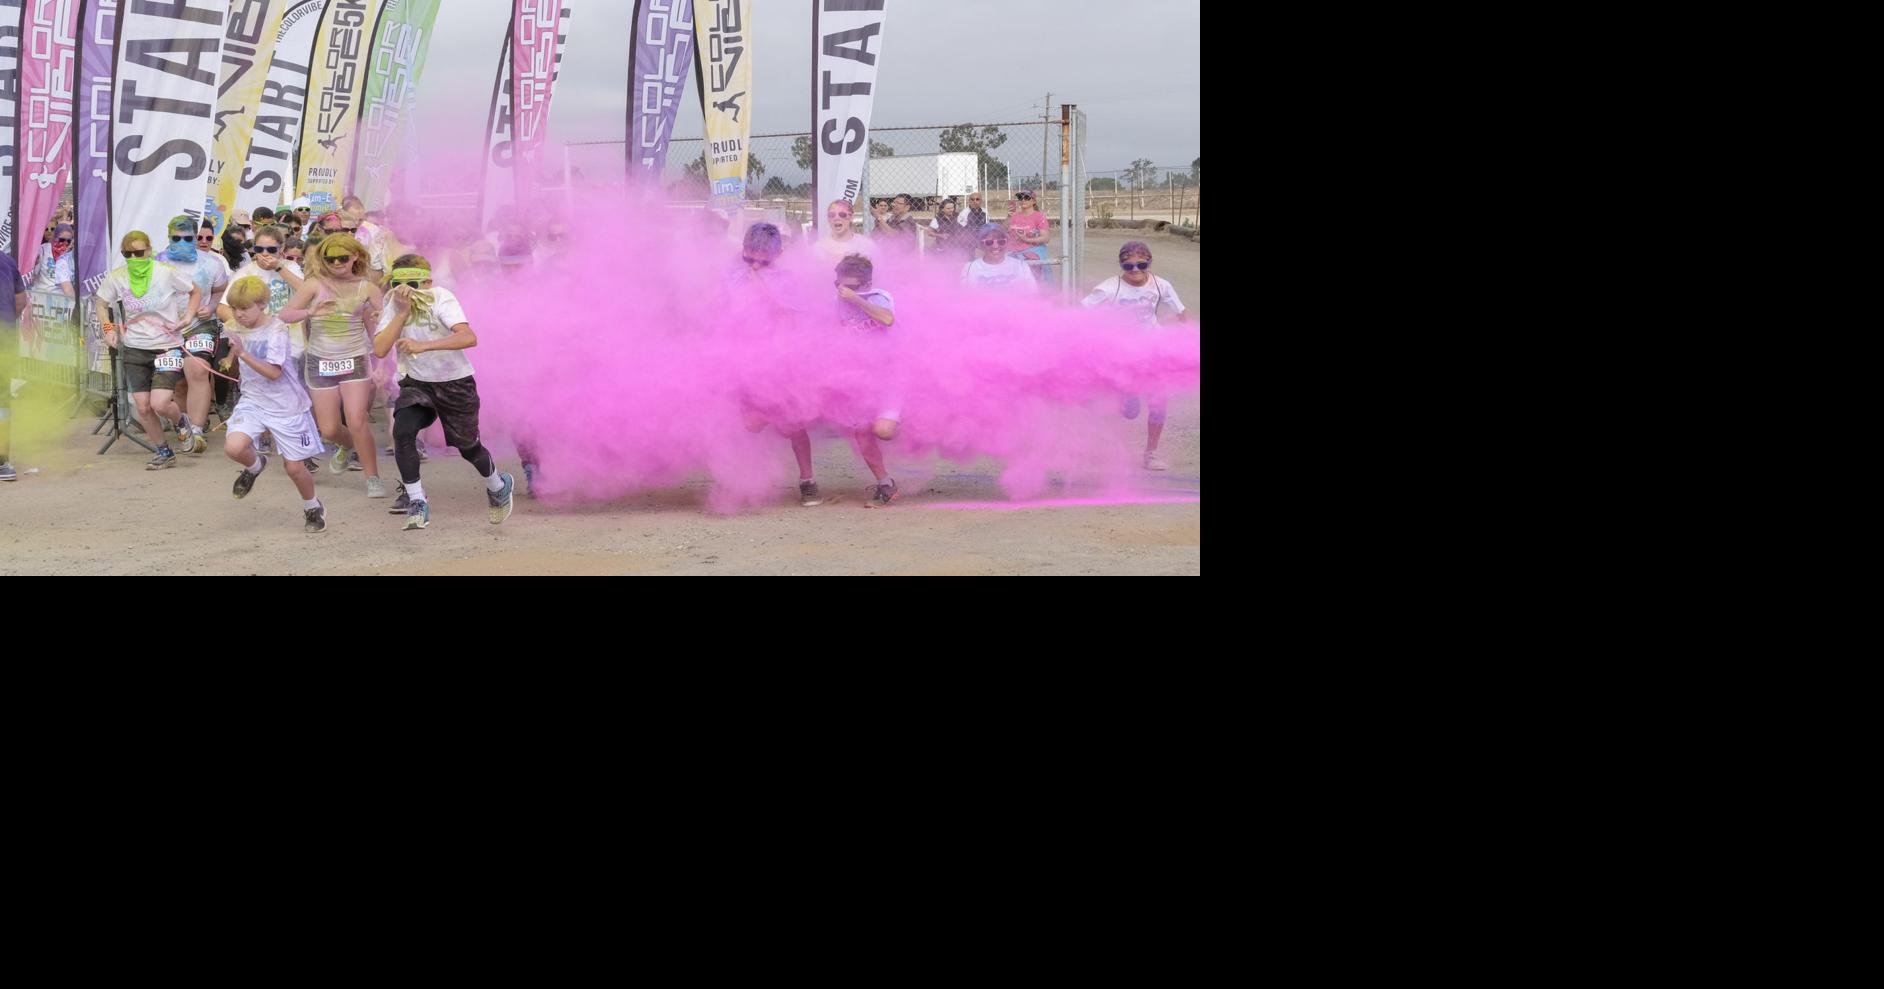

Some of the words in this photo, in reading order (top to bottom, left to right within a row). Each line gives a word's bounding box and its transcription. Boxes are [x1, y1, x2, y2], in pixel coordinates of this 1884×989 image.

[317, 27, 344, 133] COLOR
[709, 0, 725, 92] COL
[240, 50, 308, 193] START
[321, 359, 353, 372] 39933
